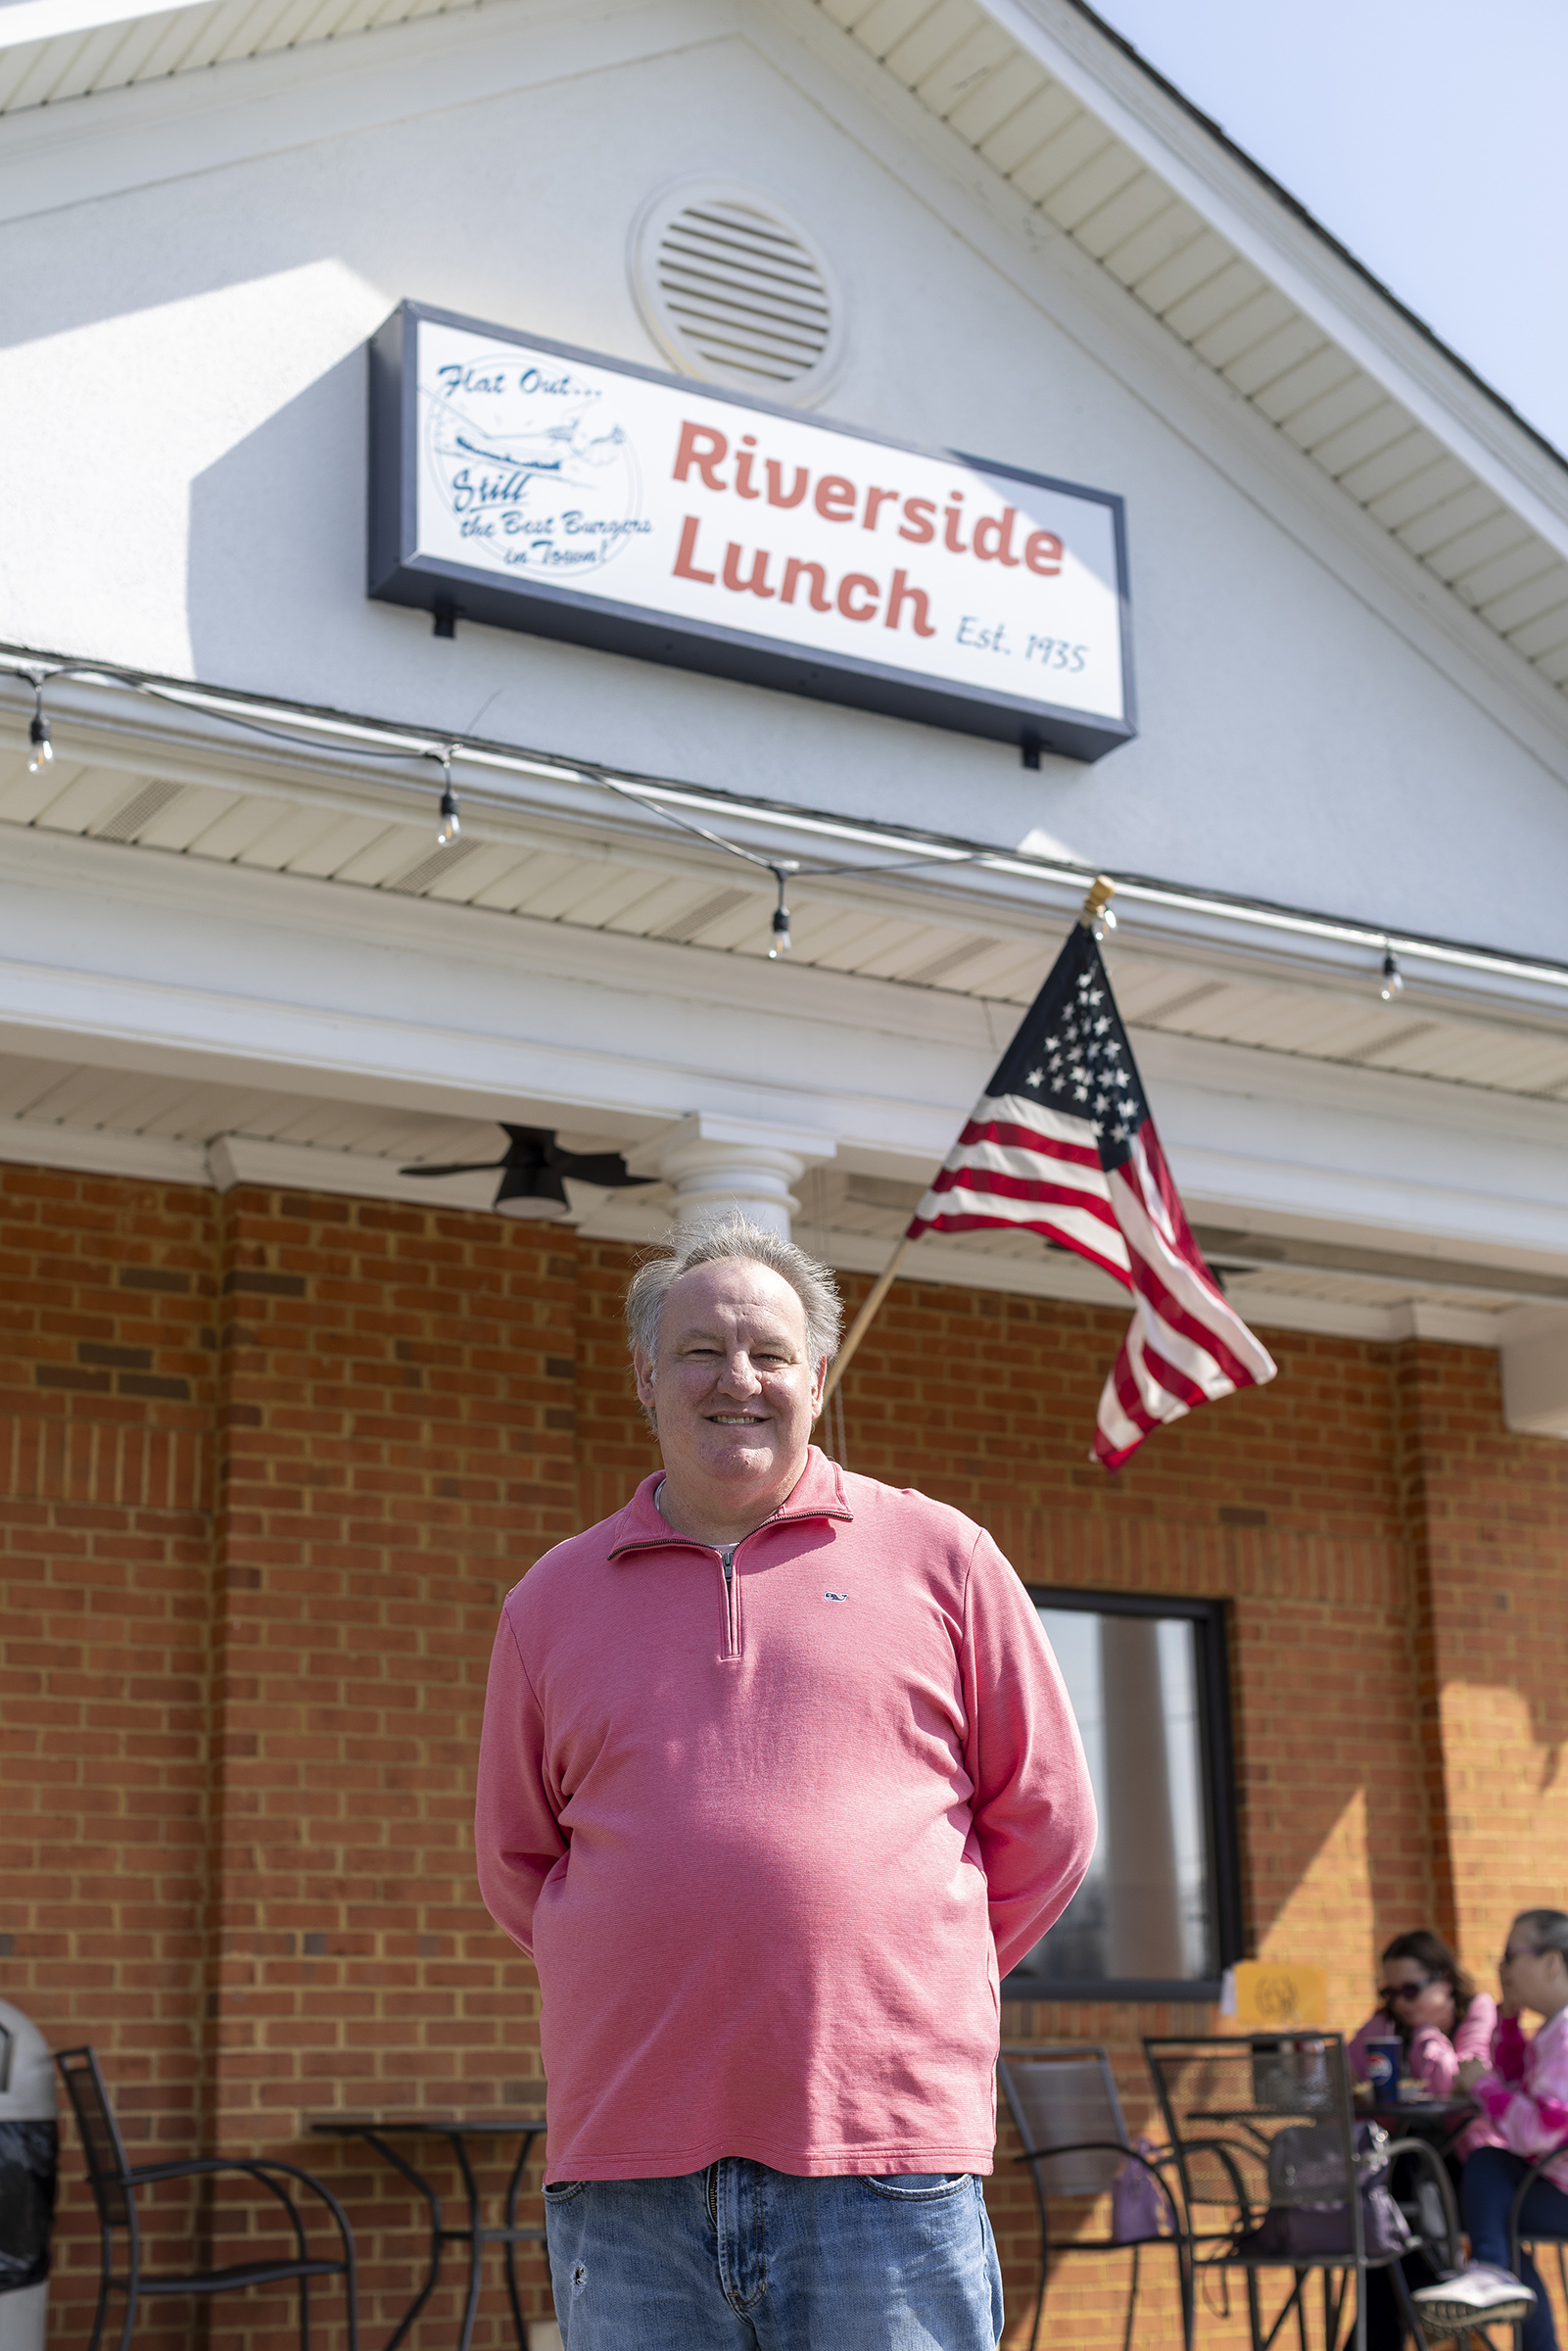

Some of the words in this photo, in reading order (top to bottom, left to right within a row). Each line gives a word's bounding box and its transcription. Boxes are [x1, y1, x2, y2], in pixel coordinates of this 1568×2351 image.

[438, 364, 505, 397] Flat
[452, 469, 530, 512] Still
[672, 419, 1065, 577] Riverside
[460, 515, 495, 538] the
[501, 510, 554, 535] Best
[561, 510, 652, 542] Burgers
[504, 548, 529, 564] in
[532, 540, 608, 565] Town!
[672, 514, 936, 638] Lunch
[956, 615, 1011, 655] Est.
[1025, 634, 1090, 673] 1935
